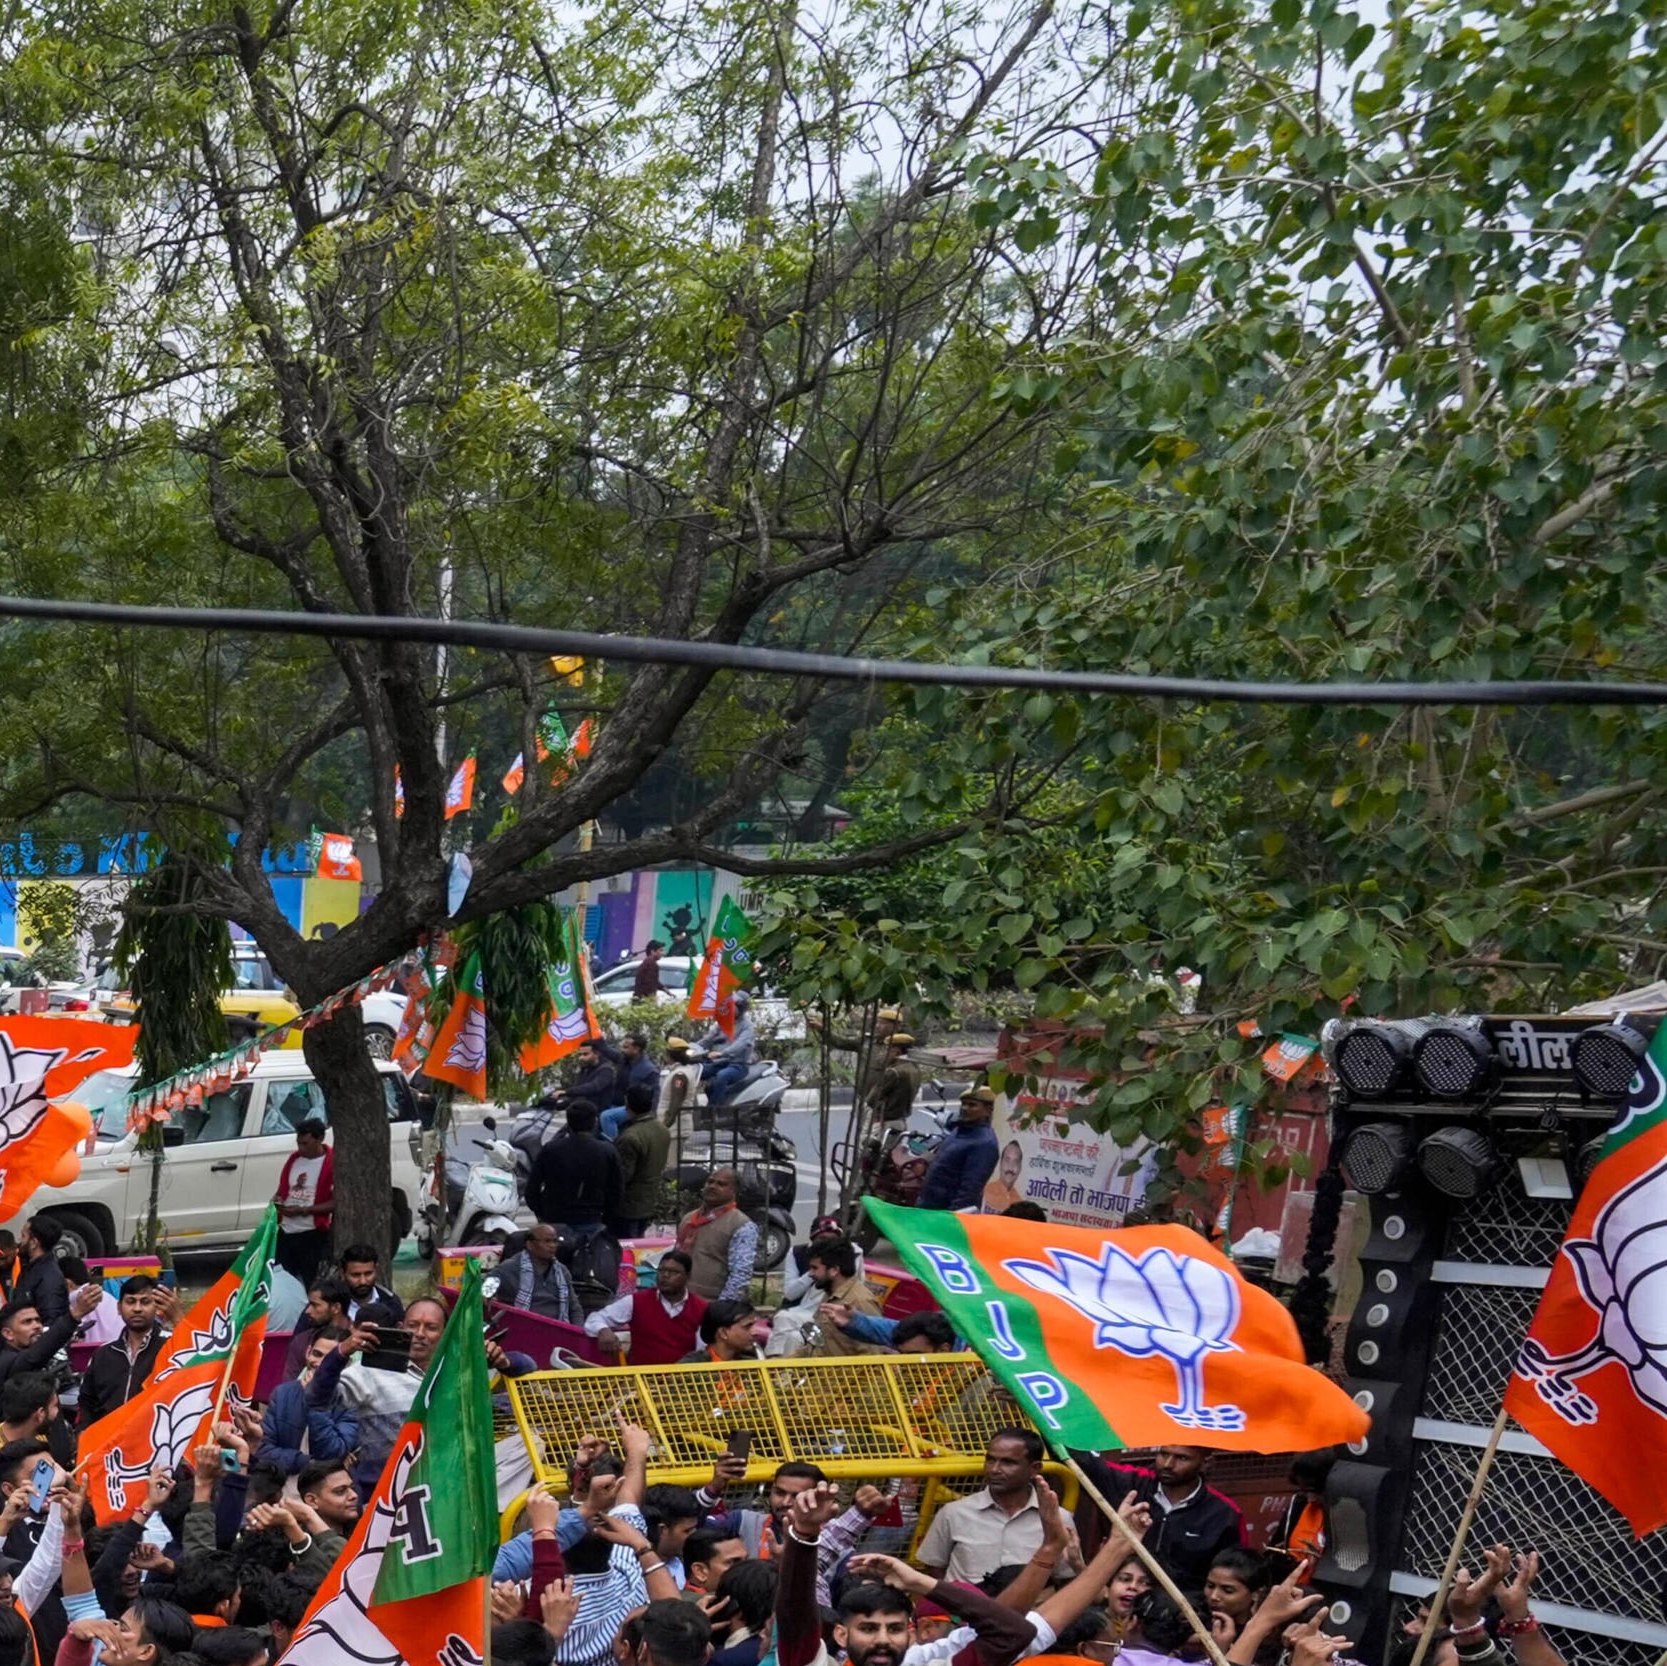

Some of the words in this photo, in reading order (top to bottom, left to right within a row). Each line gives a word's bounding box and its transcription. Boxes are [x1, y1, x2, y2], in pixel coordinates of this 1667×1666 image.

[1069, 1181, 1086, 1204] तो
[1087, 1186, 1129, 1212] भाजपा
[912, 1241, 1068, 1431] BJP
